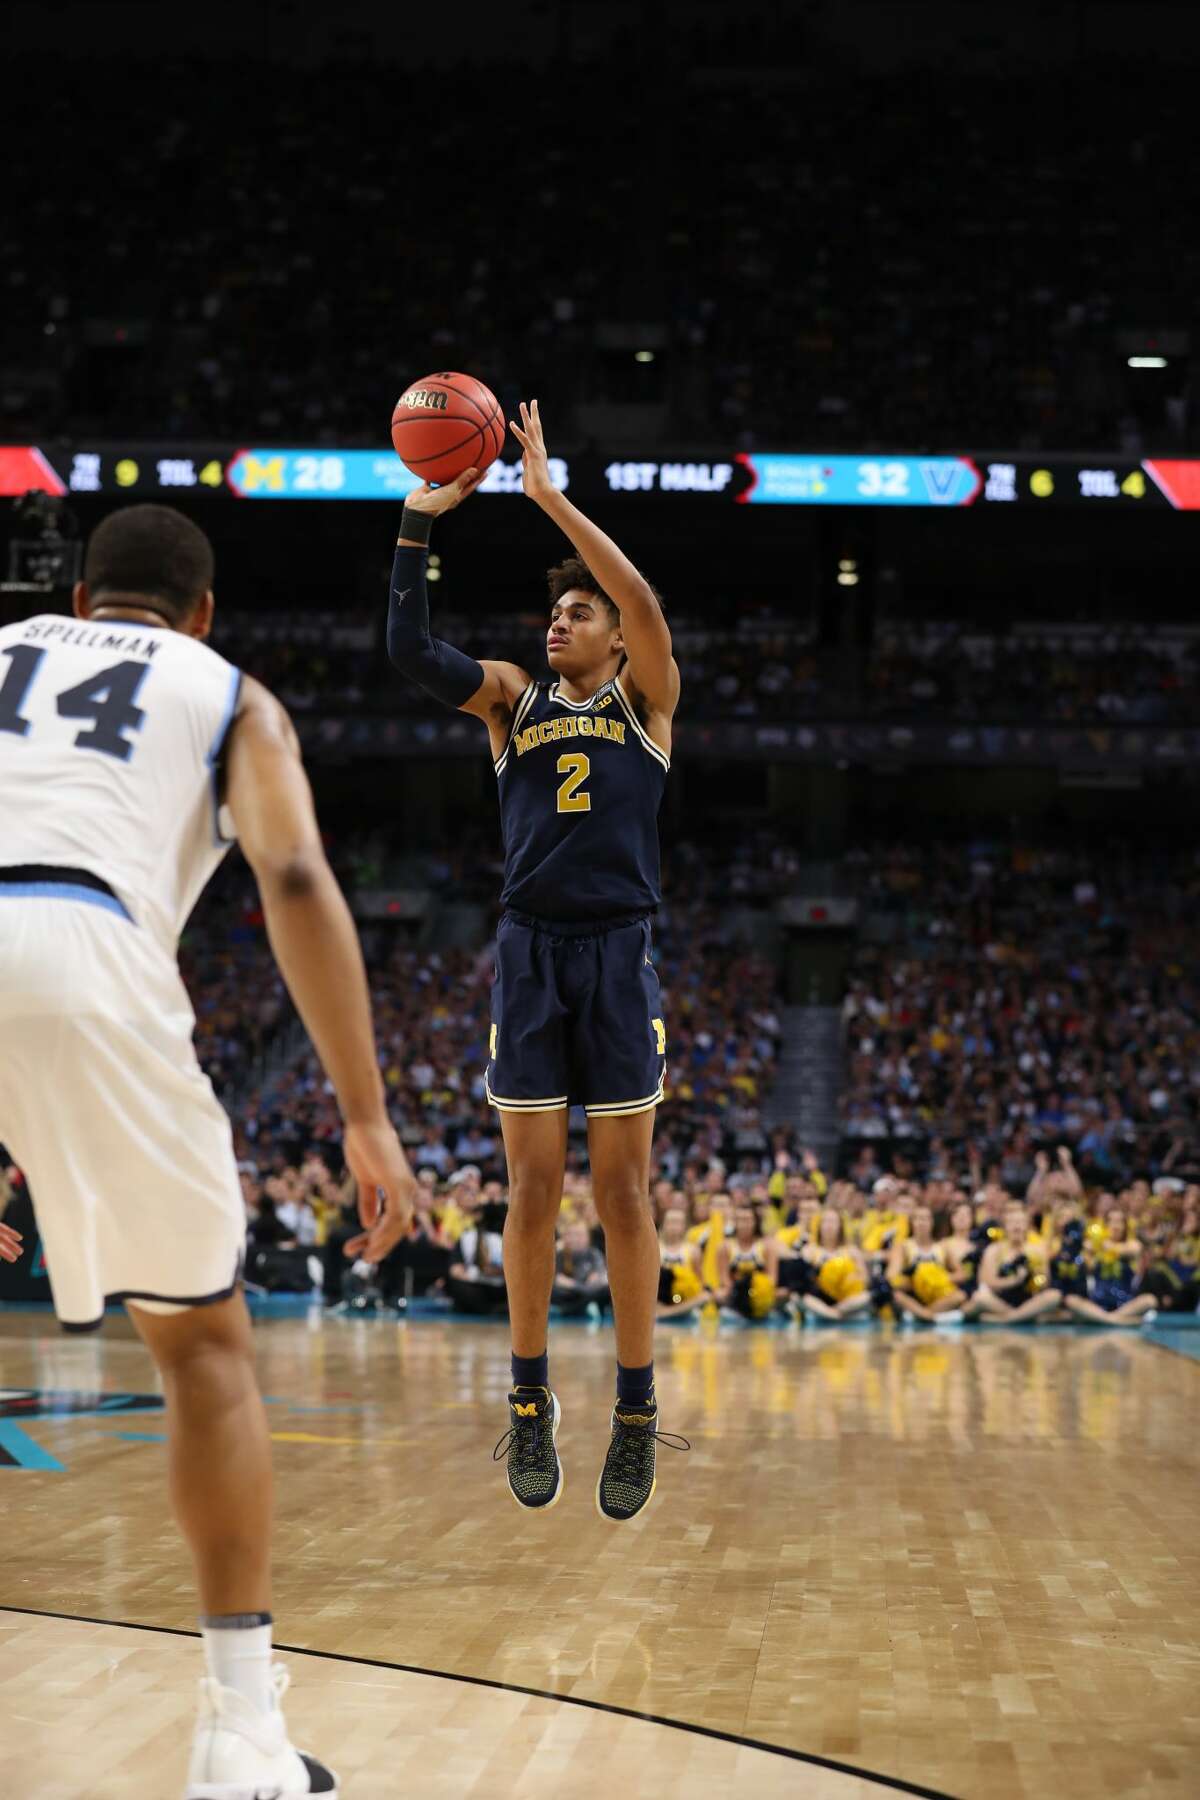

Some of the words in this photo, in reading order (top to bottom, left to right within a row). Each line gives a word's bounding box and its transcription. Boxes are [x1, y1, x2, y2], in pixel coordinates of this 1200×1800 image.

[199, 460, 223, 488] 4
[242, 457, 286, 491] M
[293, 457, 345, 491] 28
[605, 463, 657, 491] 1ST
[659, 463, 733, 492] HALF
[857, 463, 909, 497] 32
[1030, 469, 1054, 498] 6
[1121, 471, 1146, 499] 4
[0, 643, 152, 763] 14
[514, 716, 625, 756] MICHIGAN
[556, 752, 592, 813] 2
[514, 1402, 538, 1417] M
